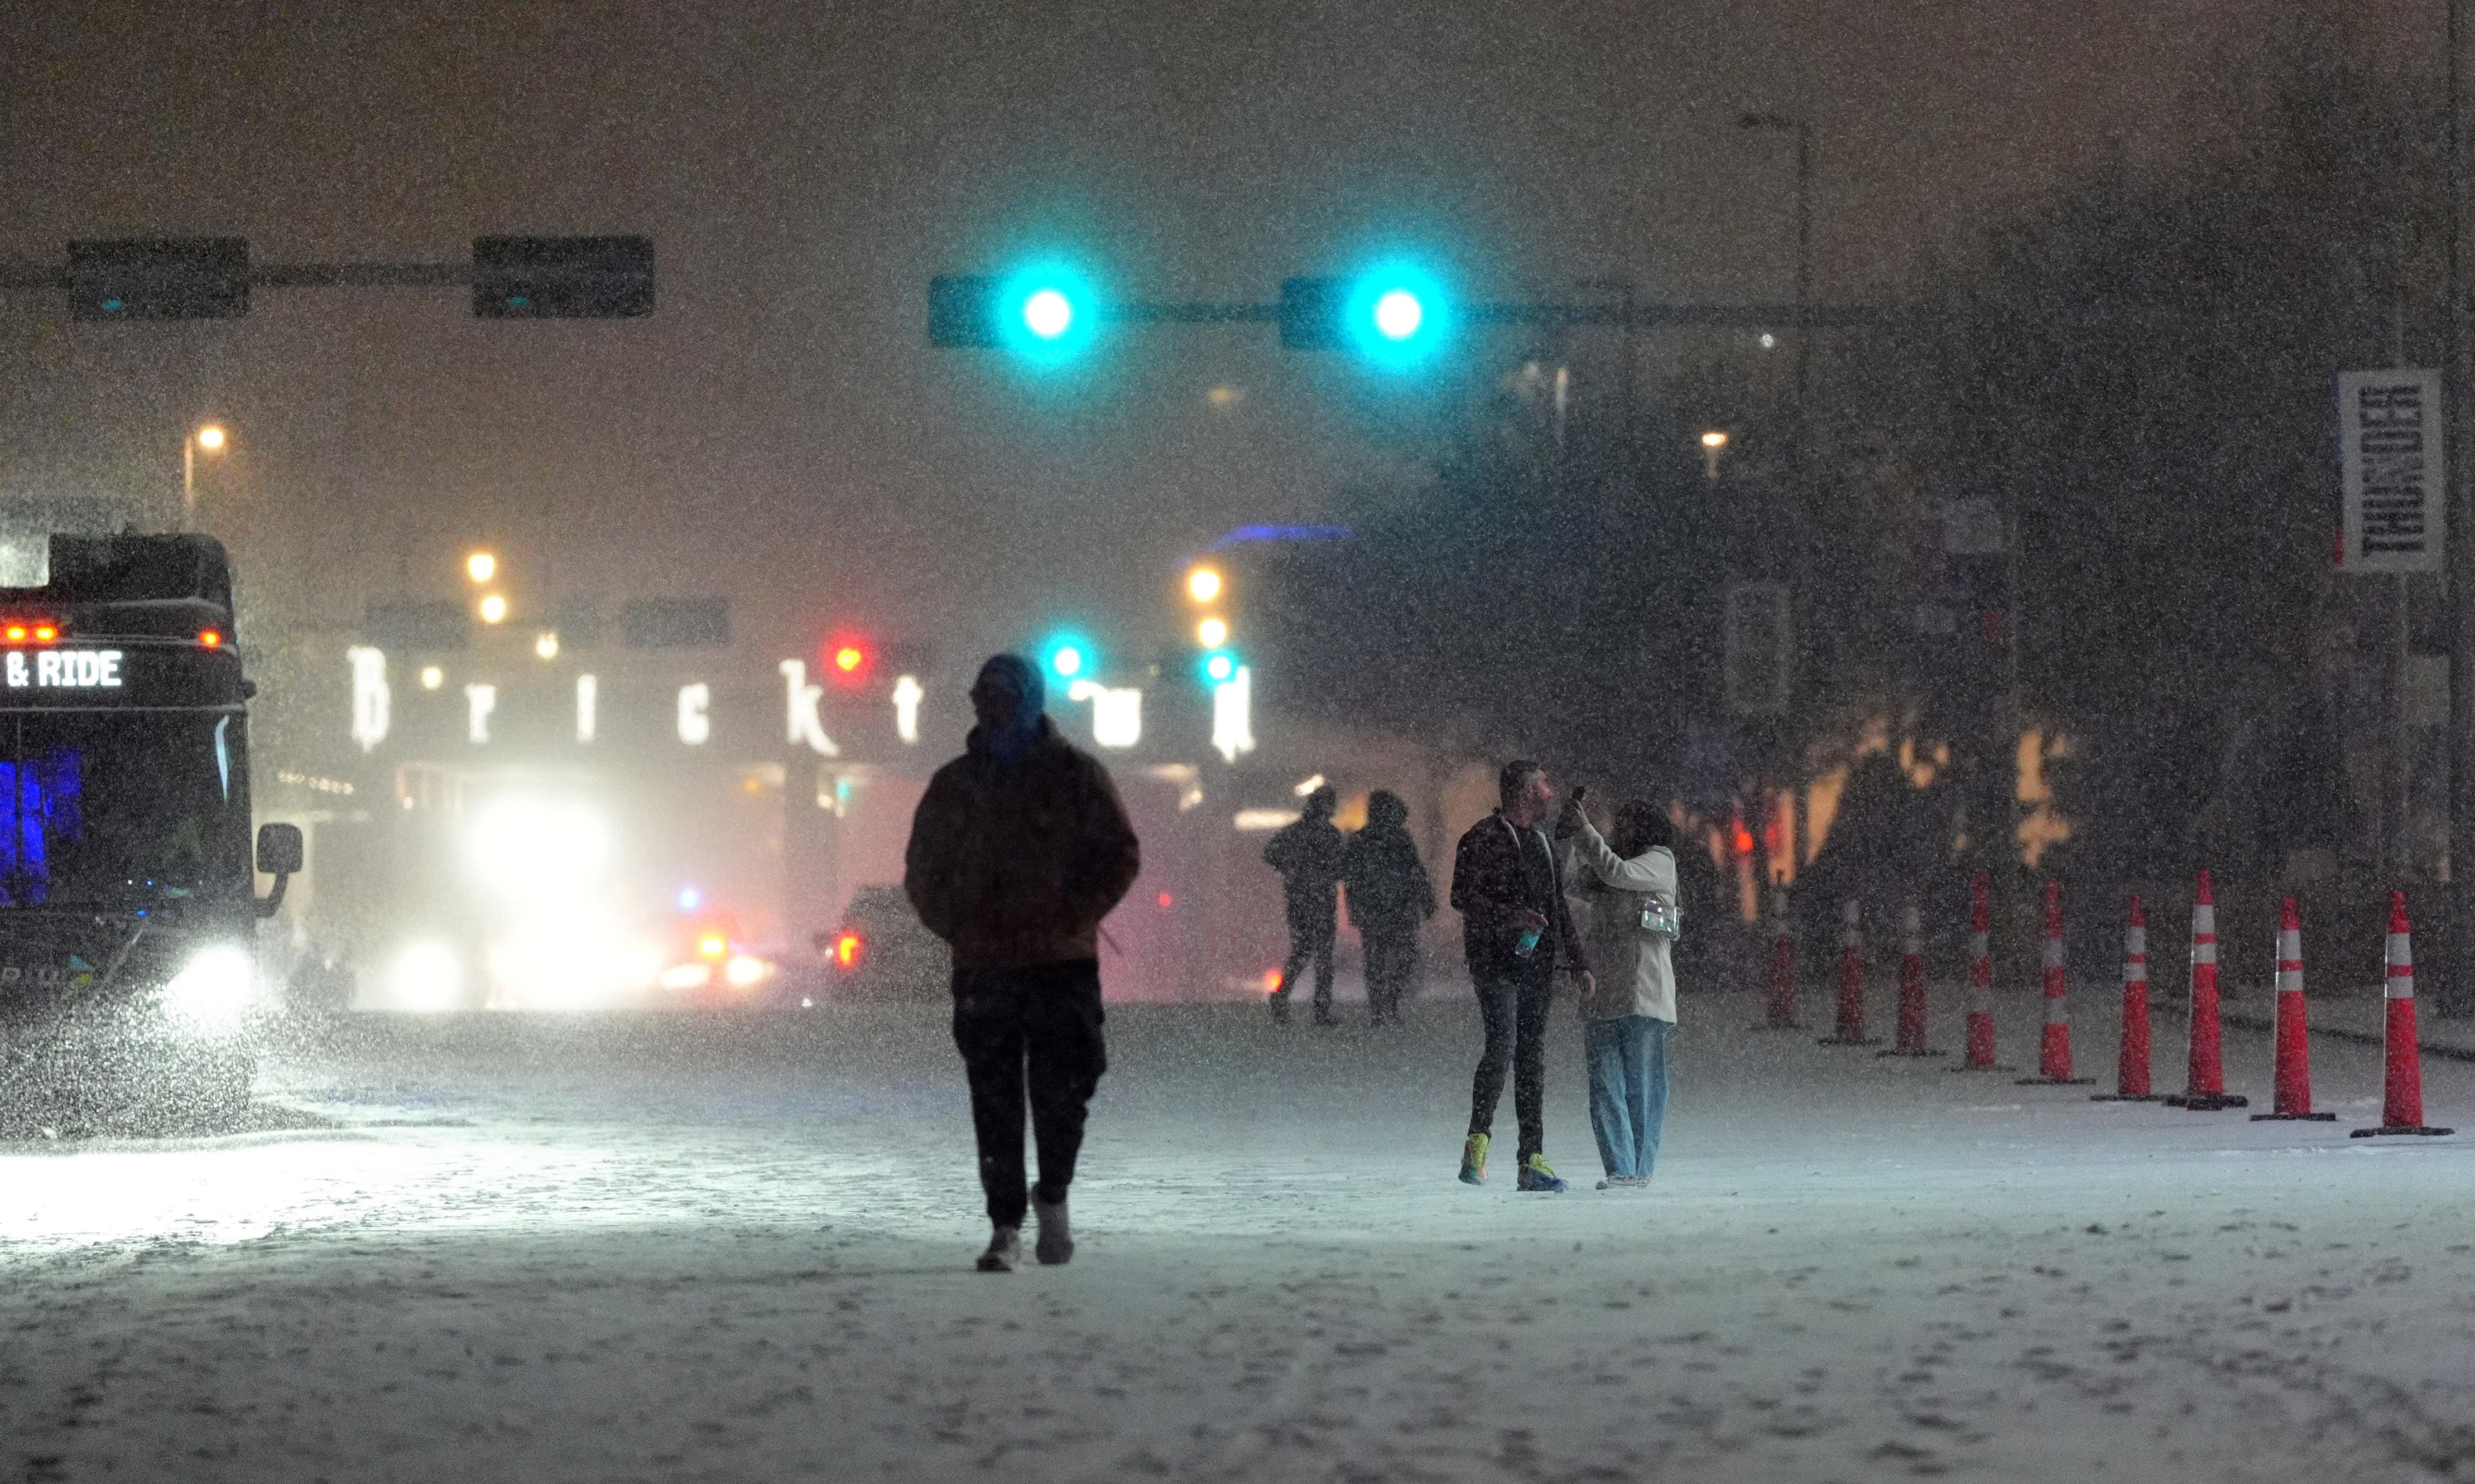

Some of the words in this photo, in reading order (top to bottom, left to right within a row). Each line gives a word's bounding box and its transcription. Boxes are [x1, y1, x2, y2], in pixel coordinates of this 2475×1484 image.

[2359, 386, 2424, 556] THUNDER
[7, 652, 28, 687] &
[38, 651, 122, 686] RIDE
[347, 645, 1257, 762] bricktwn
